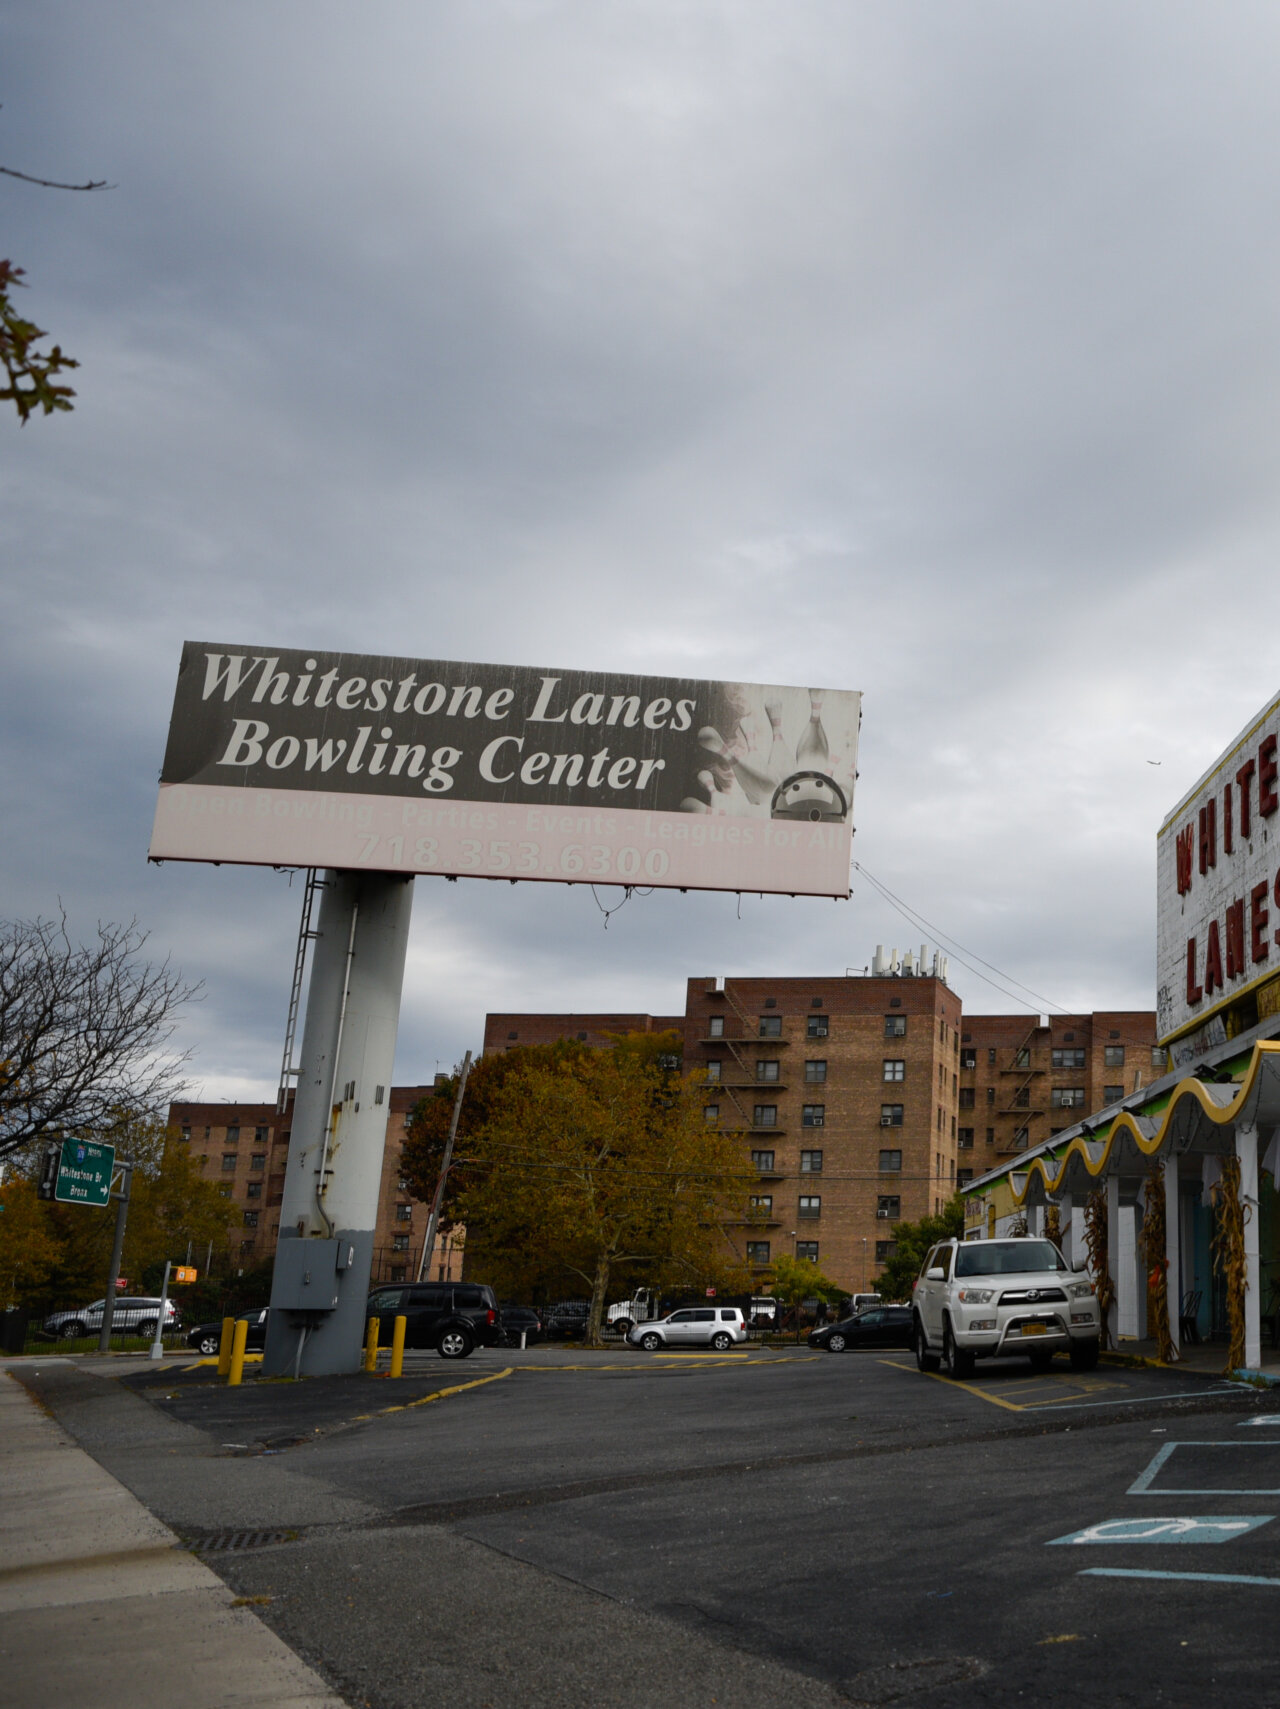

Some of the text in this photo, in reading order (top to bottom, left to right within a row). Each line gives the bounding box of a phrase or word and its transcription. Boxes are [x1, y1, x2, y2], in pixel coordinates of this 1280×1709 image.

[201, 653, 697, 731] Whitestone Lanes
[217, 719, 665, 792] Bowling Center
[255, 794, 373, 828] Bowling
[402, 802, 498, 830] Parties
[526, 810, 618, 836] Events
[644, 819, 755, 847] Leagues
[763, 826, 803, 848] for
[808, 826, 845, 851] All
[357, 832, 671, 879] 718.353.6300
[60, 1165, 93, 1182] Whitestone
[70, 1185, 88, 1197] Bronx
